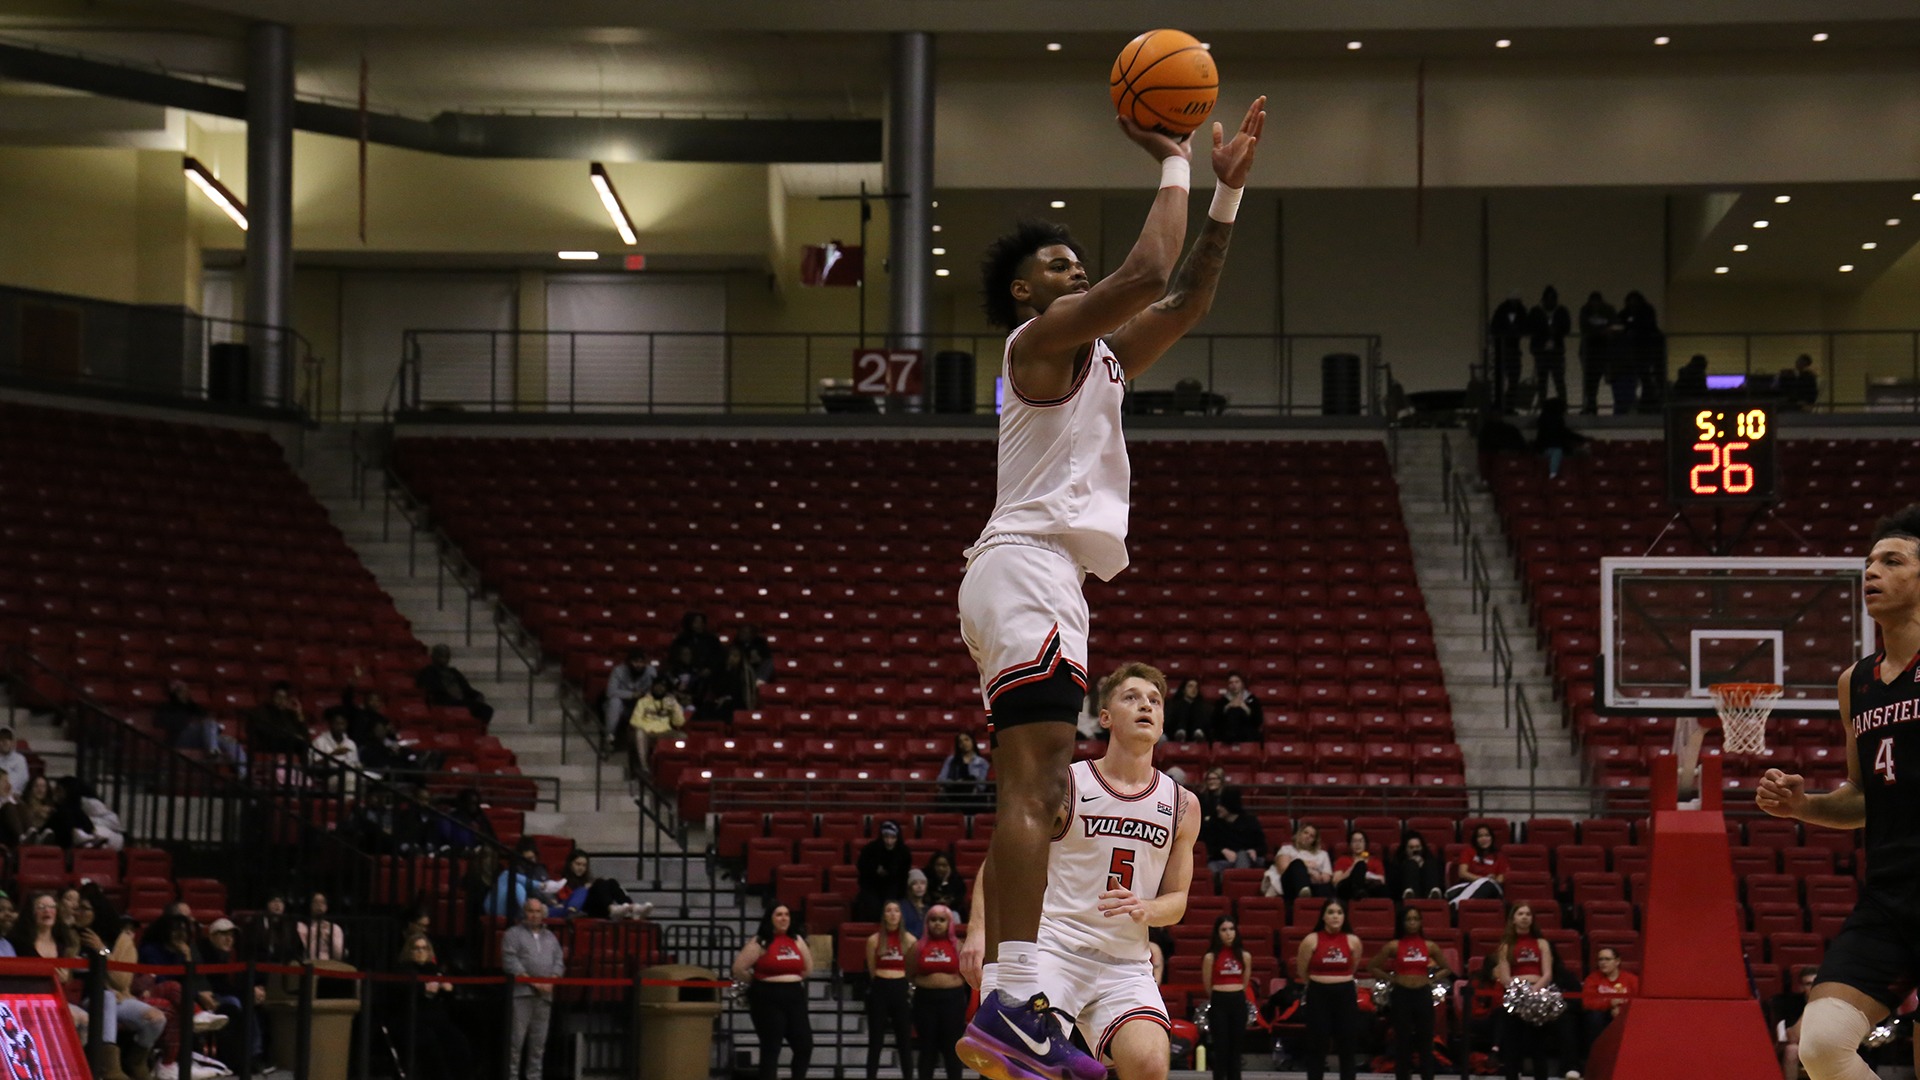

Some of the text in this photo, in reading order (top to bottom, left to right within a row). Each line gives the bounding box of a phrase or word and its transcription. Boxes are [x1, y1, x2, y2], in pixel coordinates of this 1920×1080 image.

[857, 352, 918, 392] 27
[1695, 408, 1766, 441] 5:10
[1690, 442, 1754, 494] 26
[1875, 737, 1896, 783] 4
[1084, 816, 1169, 849] VULCANS
[1106, 847, 1136, 892] 5
